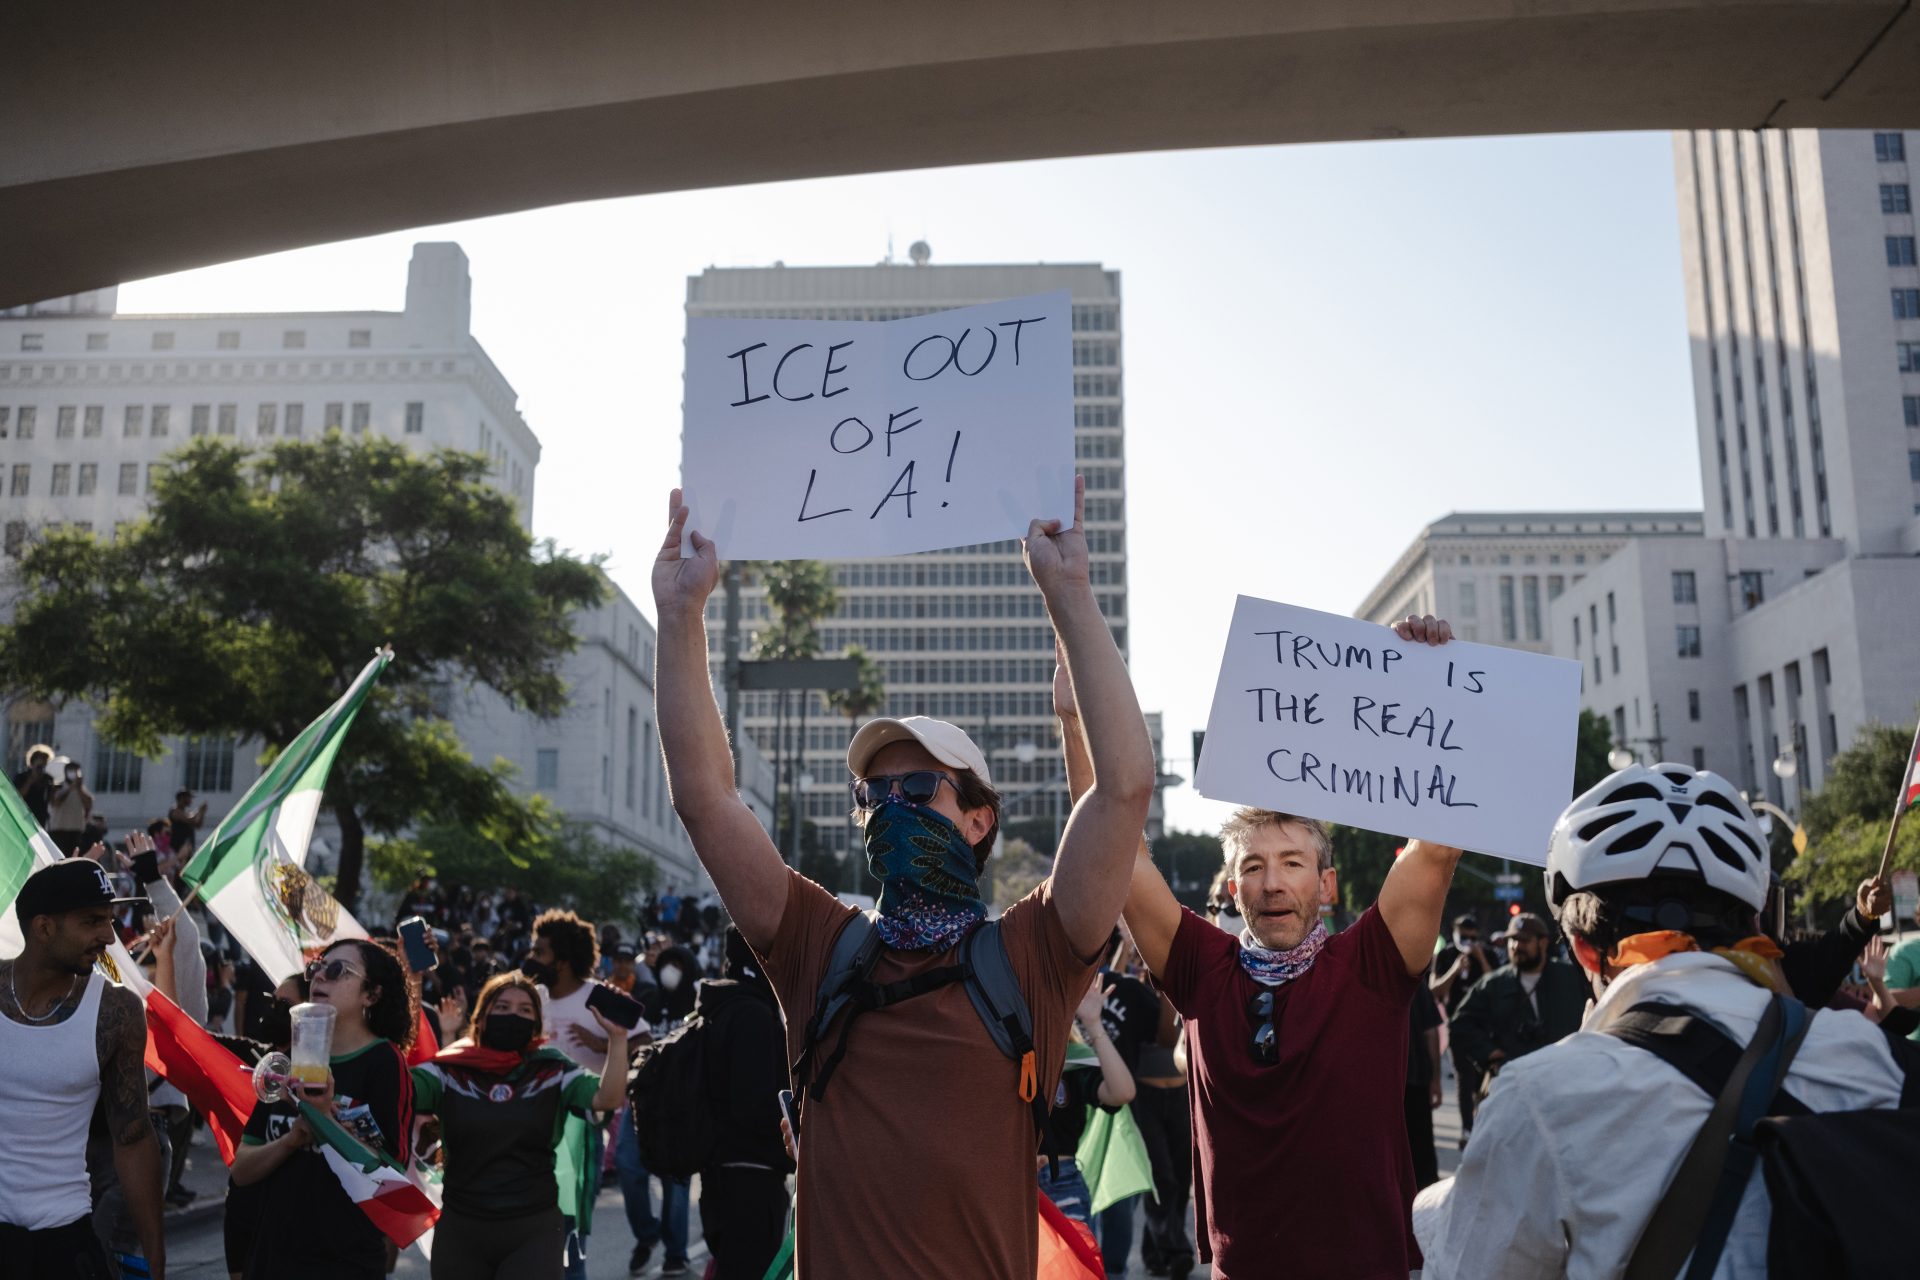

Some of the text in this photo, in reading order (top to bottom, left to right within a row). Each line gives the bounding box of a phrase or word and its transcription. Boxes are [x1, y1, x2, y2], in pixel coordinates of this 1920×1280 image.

[726, 316, 1048, 407] ICE OUT
[829, 406, 923, 457] OF
[1253, 630, 1487, 694] TRUMP IS
[1245, 687, 1465, 751] THE REAL
[1266, 748, 1480, 808] CRIMINAL
